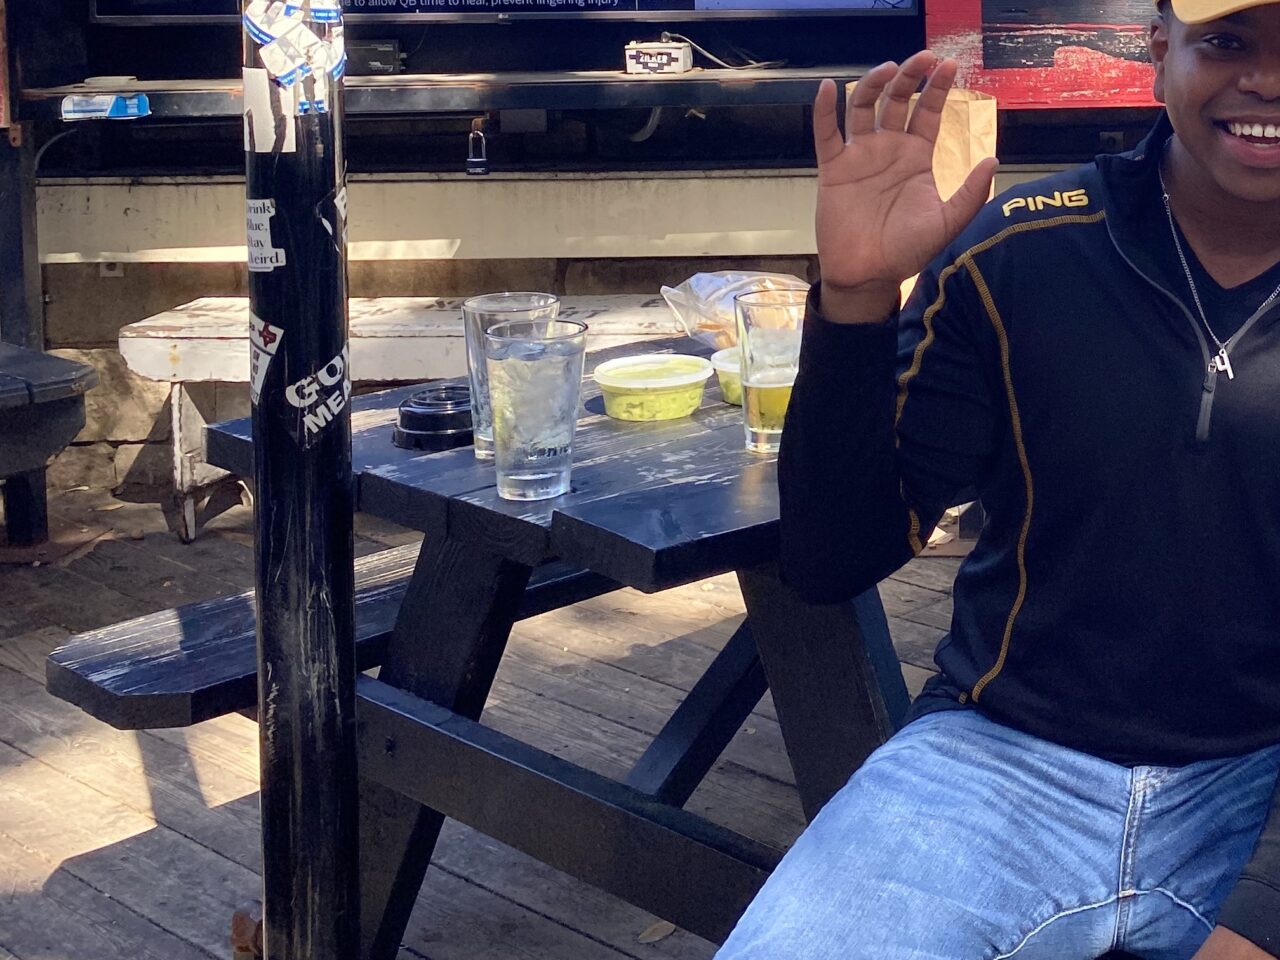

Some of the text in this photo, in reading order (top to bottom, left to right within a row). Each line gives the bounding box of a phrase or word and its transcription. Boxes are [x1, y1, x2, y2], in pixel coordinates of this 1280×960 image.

[247, 201, 271, 214] rink
[1002, 188, 1089, 217] PING
[247, 217, 268, 232] lue.
[247, 234, 266, 250] tay
[249, 251, 284, 265] eird.
